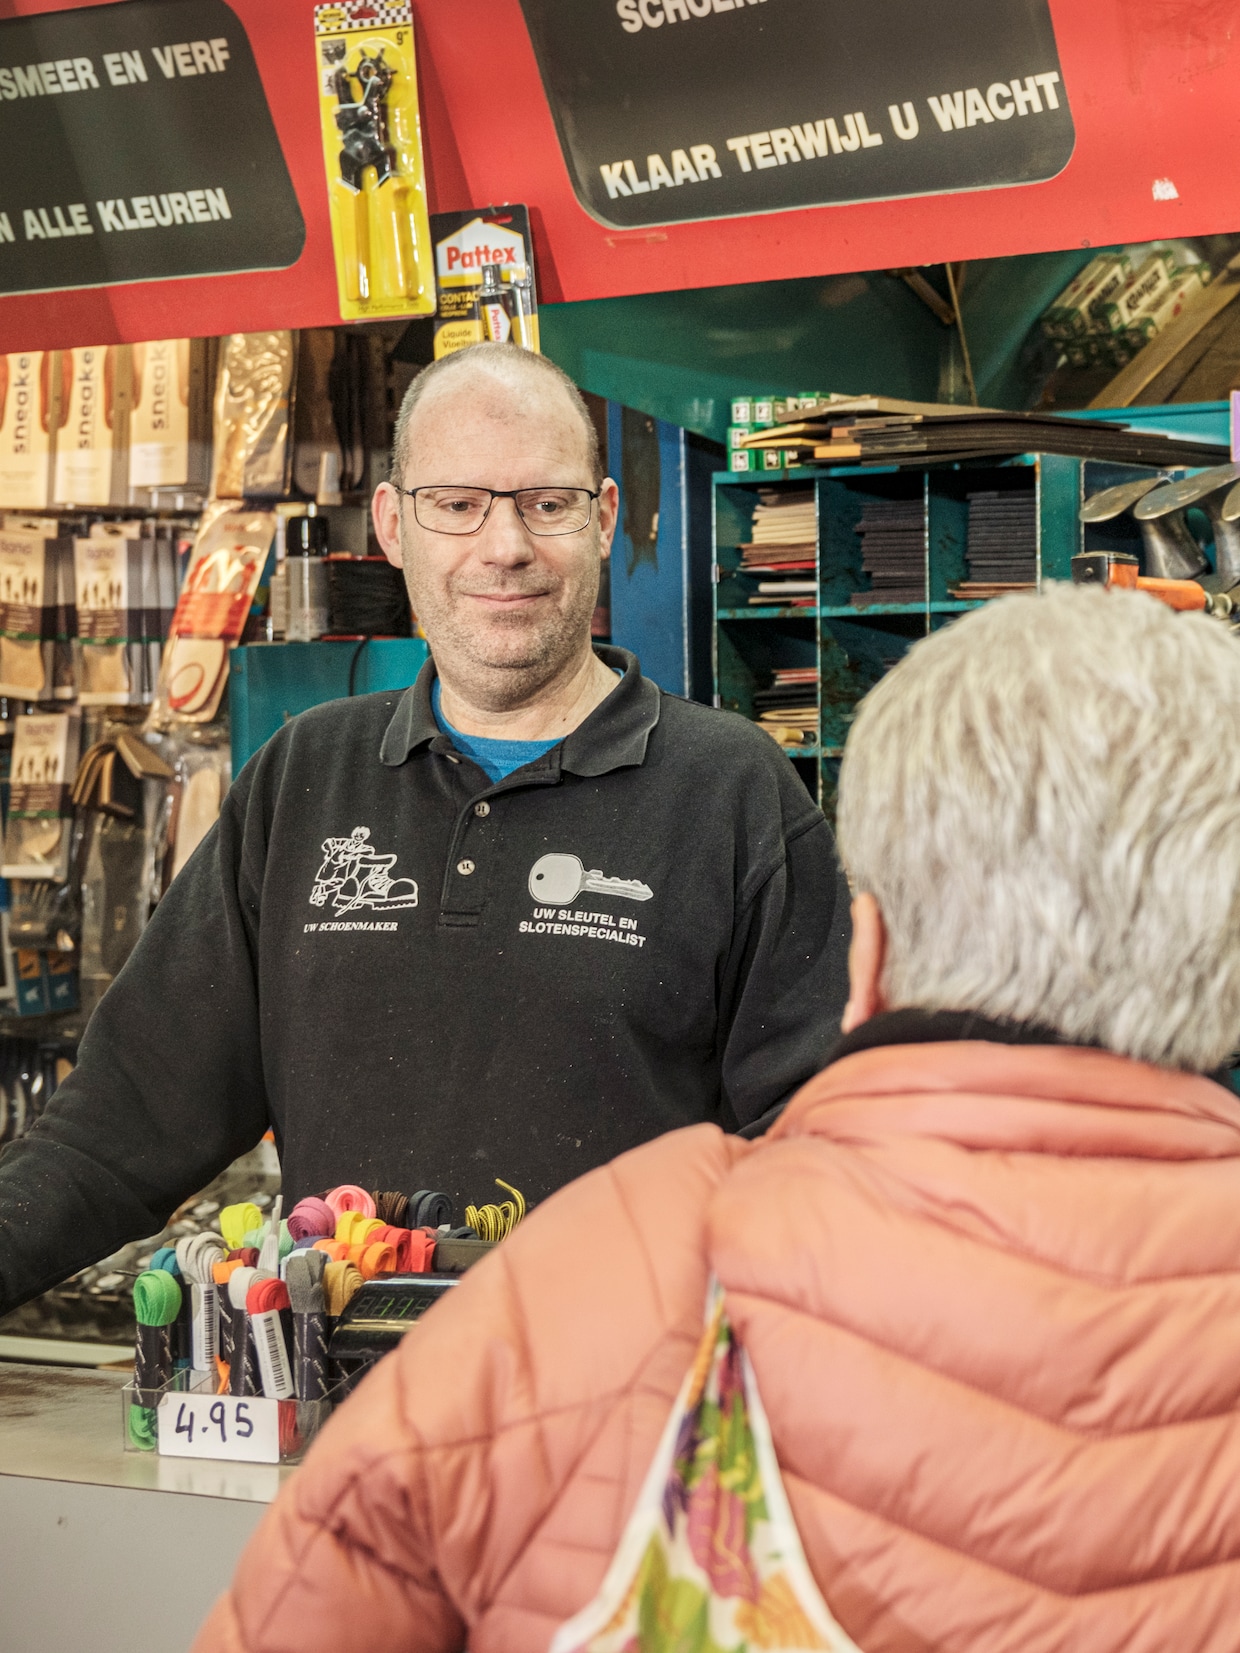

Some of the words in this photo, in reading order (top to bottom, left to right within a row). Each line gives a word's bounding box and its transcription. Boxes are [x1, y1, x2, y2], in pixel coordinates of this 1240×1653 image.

[0, 56, 100, 100] SMEER
[102, 50, 148, 86] EN
[152, 37, 230, 79] VERF
[600, 143, 722, 199] KLAAR
[726, 111, 883, 173] TERWIJL
[888, 101, 919, 140] U
[927, 71, 1060, 132] WACHT
[23, 203, 94, 240] ALLE
[96, 187, 232, 232] KLEUREN
[446, 244, 516, 270] Pattex
[440, 291, 481, 305] CONTAC
[491, 309, 502, 341] Pattex
[303, 923, 318, 933] UW
[319, 921, 399, 932] SCHOENMAKER
[518, 920, 646, 948] SLOTENSPECIALIST
[533, 907, 556, 919] UW
[558, 909, 617, 927] SLEUTEL
[619, 917, 638, 931] EN
[175, 1401, 254, 1443] 4.95
